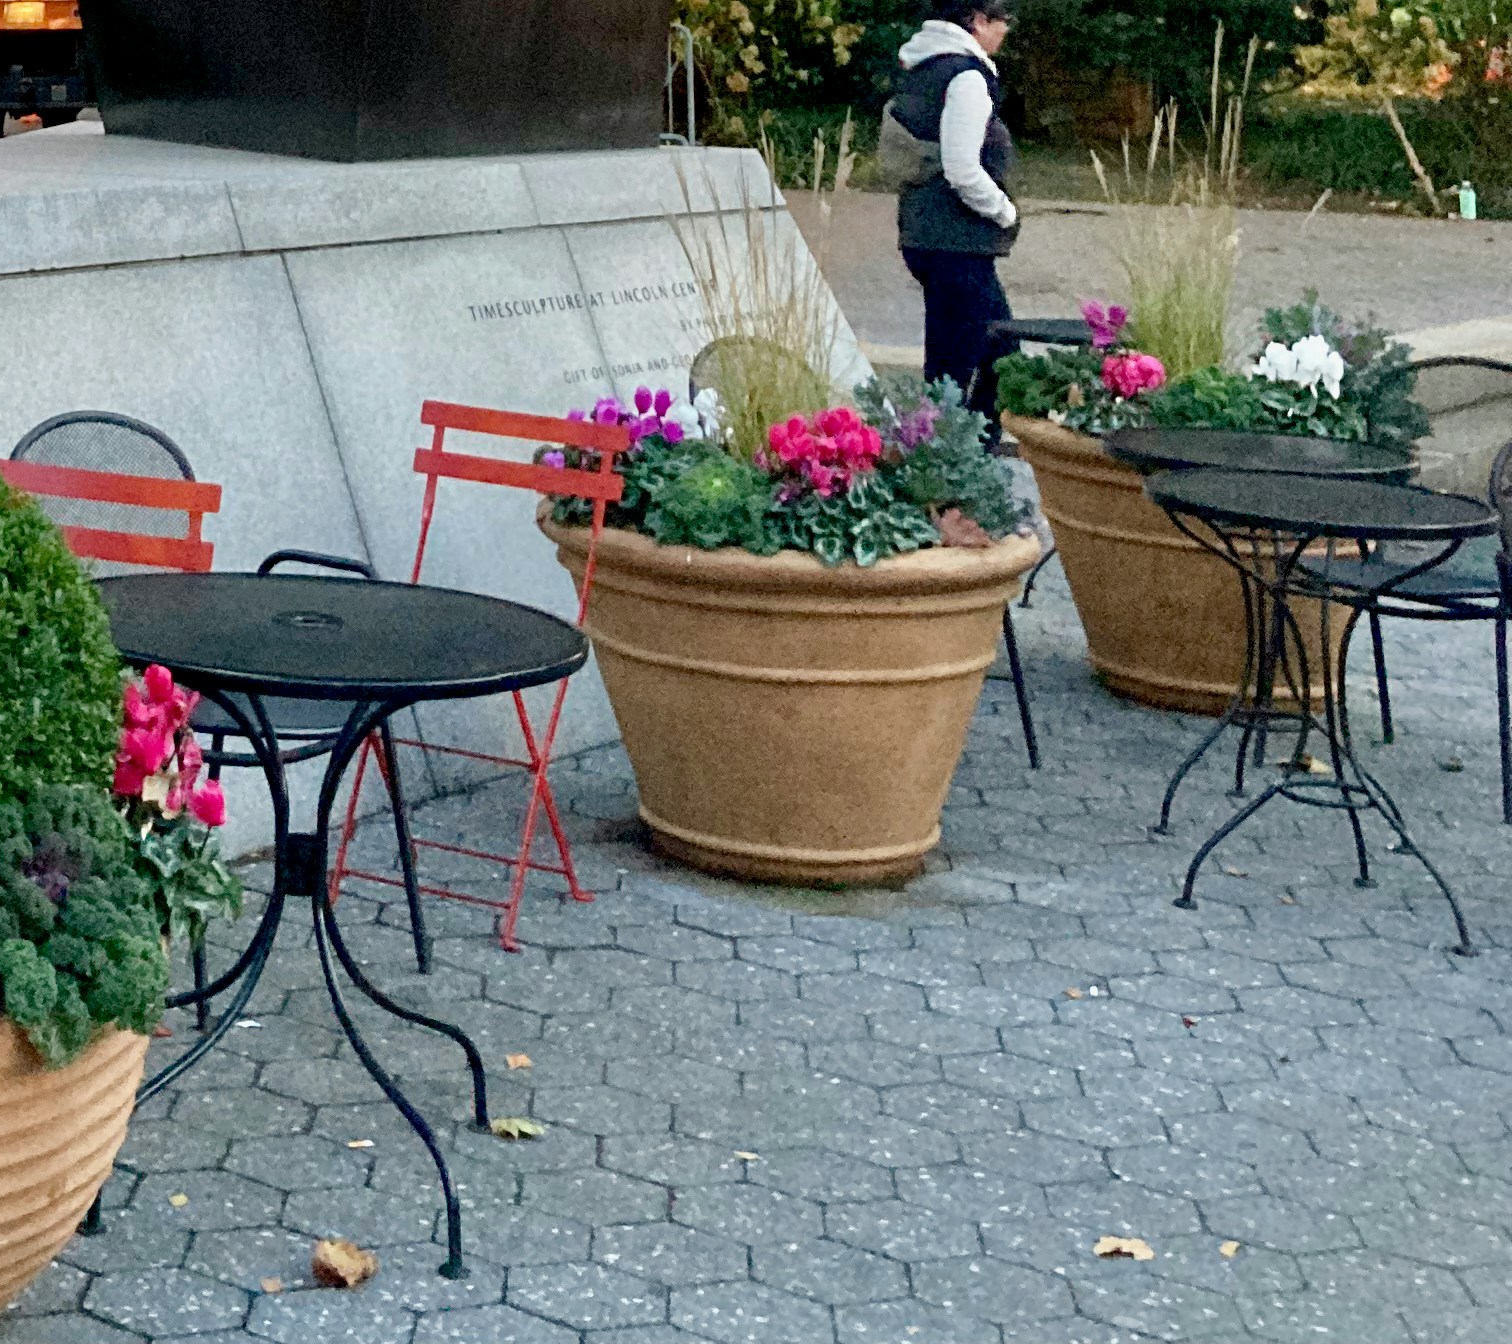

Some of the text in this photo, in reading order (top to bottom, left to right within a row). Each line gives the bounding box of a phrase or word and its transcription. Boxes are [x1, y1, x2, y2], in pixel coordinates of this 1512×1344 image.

[468, 293, 585, 322] TIMESCULPTURE
[589, 291, 605, 308] AT
[610, 285, 670, 306] LINCOLN
[563, 369, 587, 385] GIFT
[647, 360, 669, 373] AND
